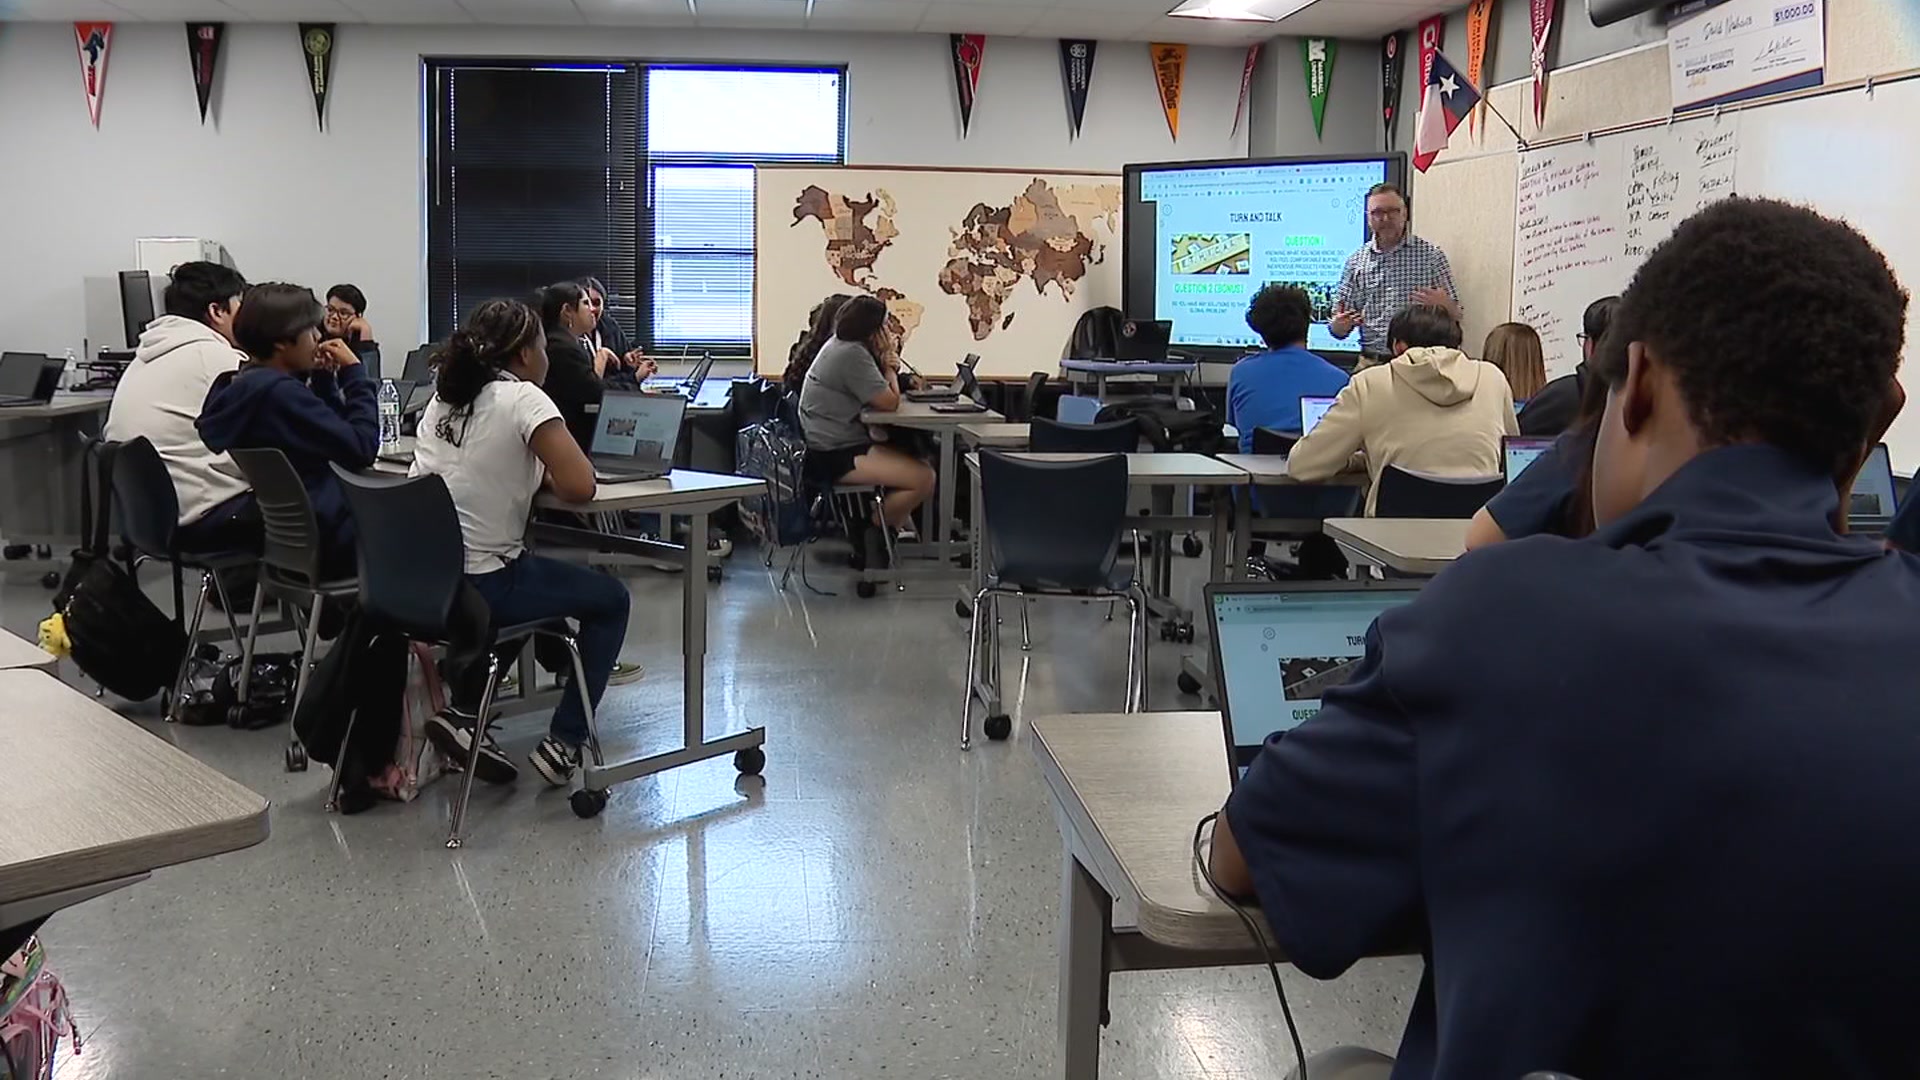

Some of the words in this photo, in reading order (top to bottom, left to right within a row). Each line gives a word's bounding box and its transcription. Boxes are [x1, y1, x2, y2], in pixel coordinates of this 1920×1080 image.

[1230, 212, 1249, 222] TURN
[1250, 212, 1264, 222] AND
[1265, 212, 1282, 222] TALK
[1285, 236, 1320, 247] QUESTION
[1175, 284, 1207, 294] QUESTION
[1208, 284, 1214, 294] 2
